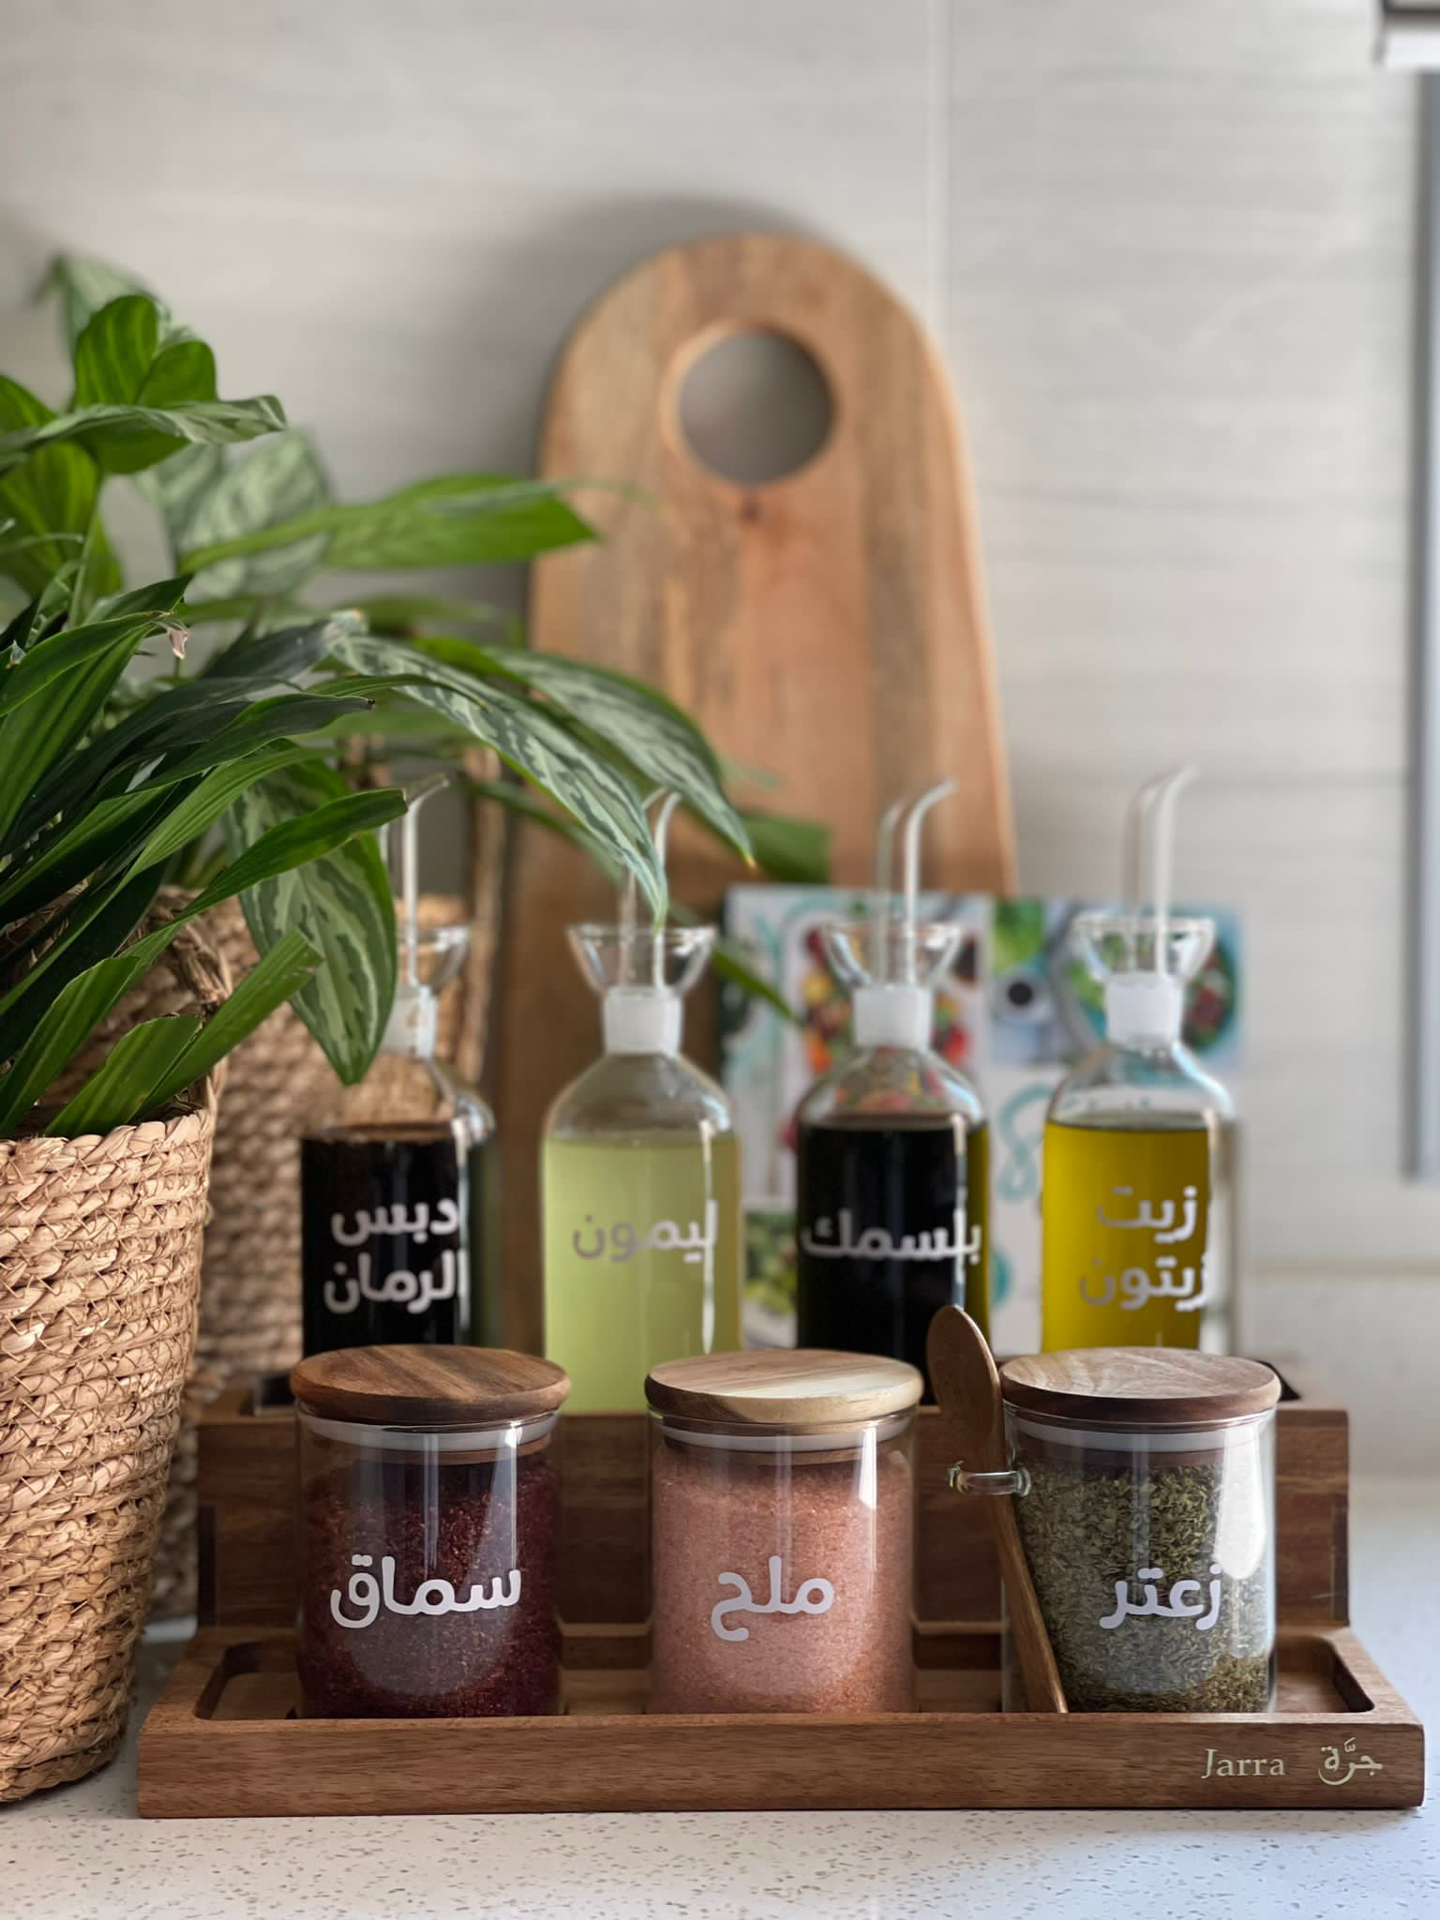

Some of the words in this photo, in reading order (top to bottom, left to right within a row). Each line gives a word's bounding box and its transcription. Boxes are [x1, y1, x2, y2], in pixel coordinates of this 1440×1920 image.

[331, 1198, 459, 1247] دبس
[572, 1198, 719, 1265] ليمون
[801, 1207, 982, 1265] بلسمك
[1095, 1184, 1198, 1244] زيت
[323, 1248, 469, 1315] الرمان
[330, 1553, 522, 1629] سماق
[711, 1555, 835, 1642] ملح
[1099, 1563, 1222, 1630] زعتر
[1201, 1748, 1286, 1779] Jarra
